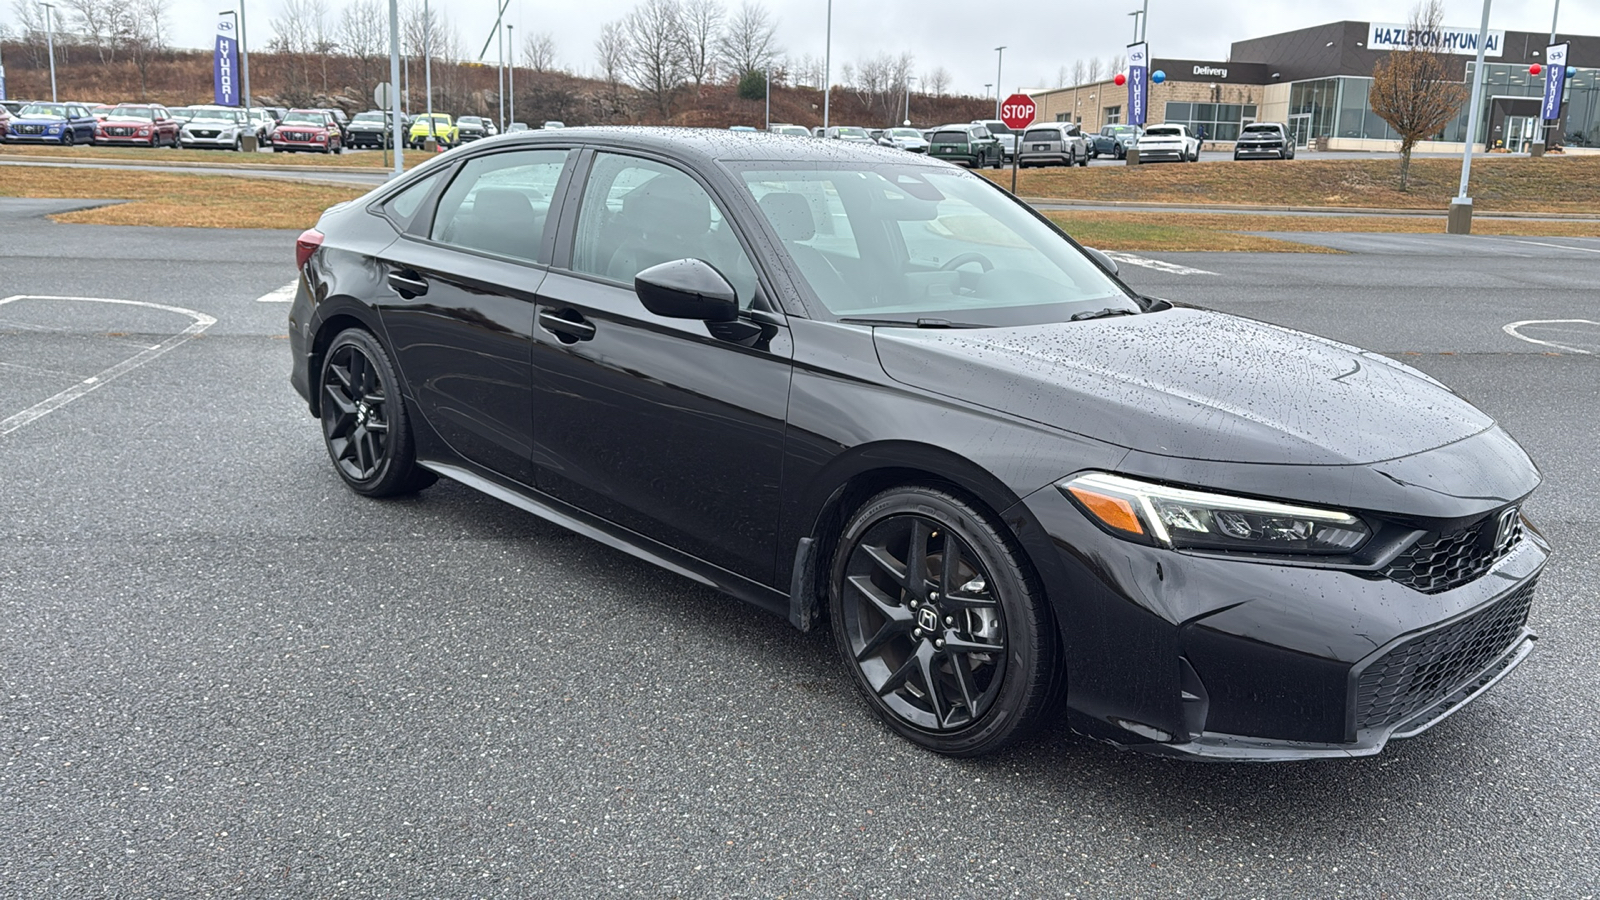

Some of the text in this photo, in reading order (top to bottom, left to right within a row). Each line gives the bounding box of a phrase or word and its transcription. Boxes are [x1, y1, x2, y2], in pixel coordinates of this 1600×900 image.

[1374, 27, 1498, 51] HAZLETON HYUNAI
[220, 40, 231, 103] HYUNDAI
[1193, 65, 1228, 78] Delivery
[1133, 68, 1141, 123] HYUNDAI
[1546, 66, 1559, 118] HYUNDAI
[1002, 104, 1034, 119] STOP
